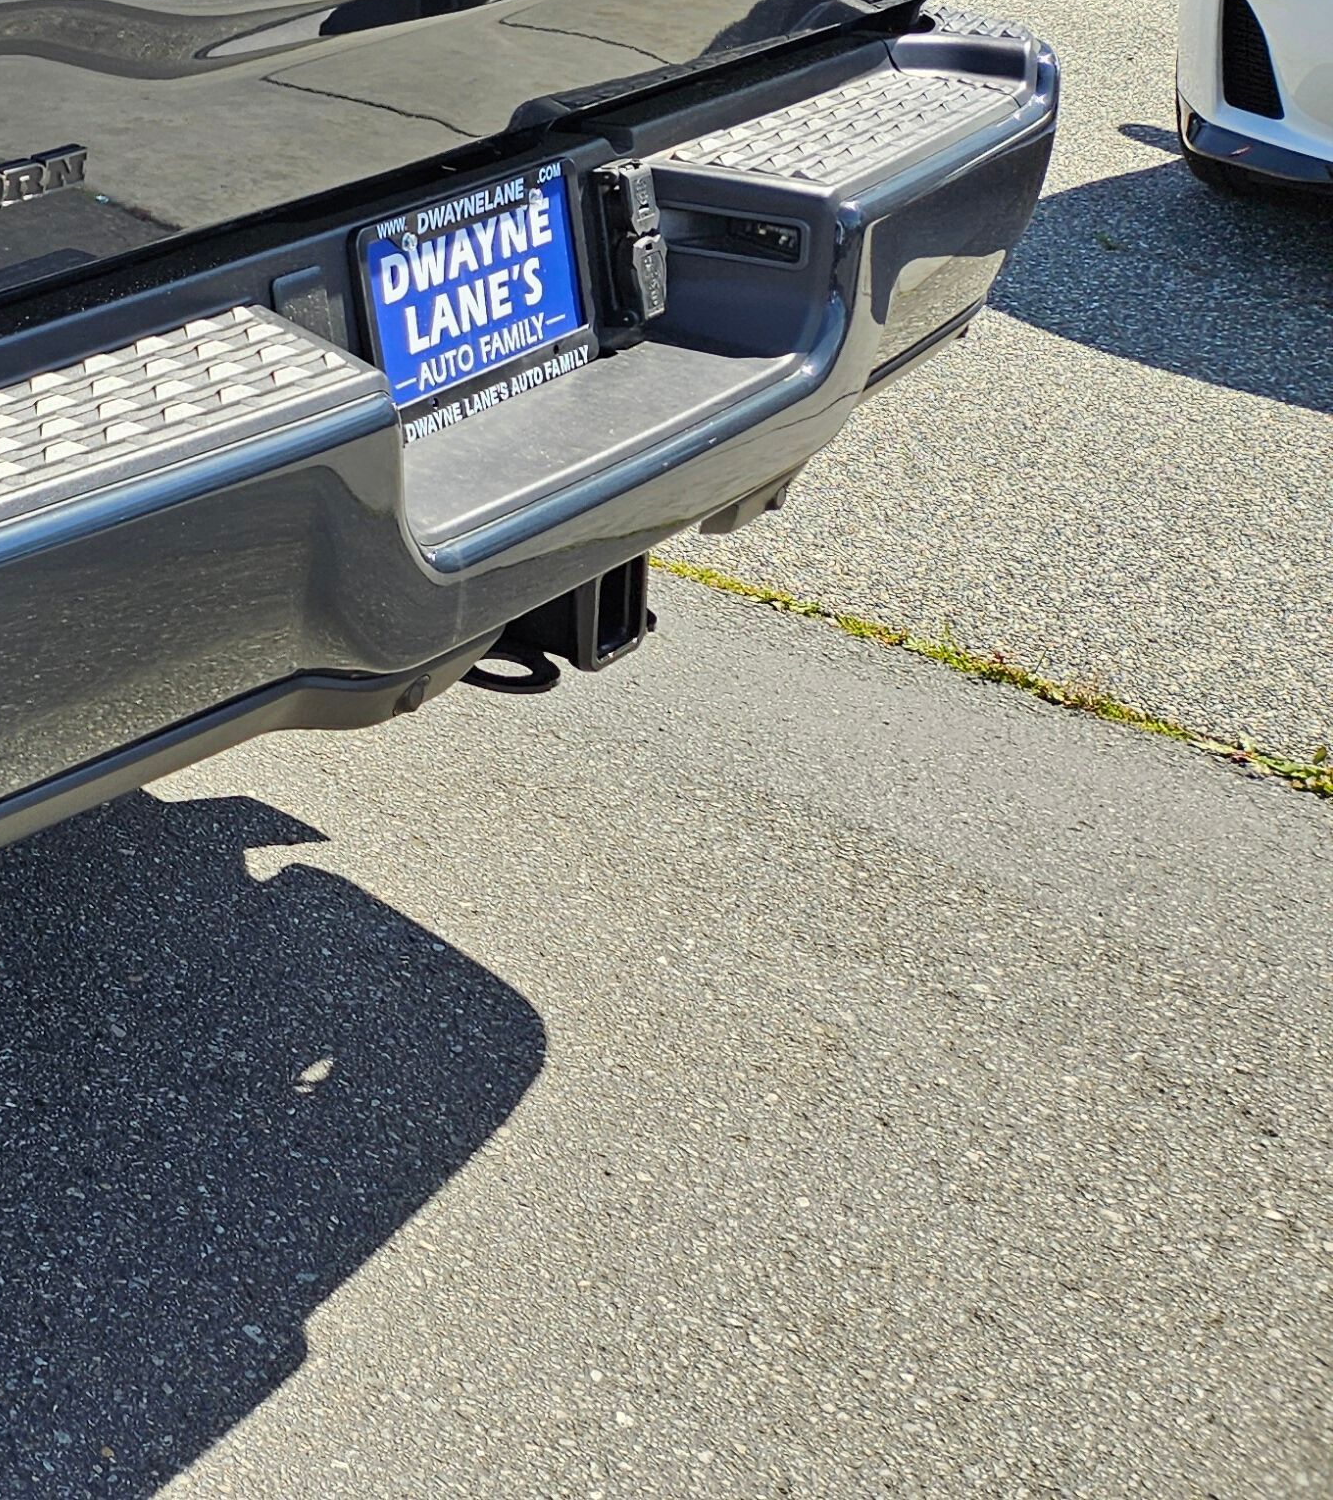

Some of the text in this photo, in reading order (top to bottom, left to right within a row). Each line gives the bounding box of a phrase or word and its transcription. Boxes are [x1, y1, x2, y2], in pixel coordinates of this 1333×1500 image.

[417, 177, 525, 235] DWAYNELANE
[537, 162, 562, 184] .COM
[380, 196, 553, 305] DWAYNE
[404, 256, 543, 356] LANE'S
[418, 312, 545, 392] AUTO FAMILY
[403, 345, 590, 444] DWAYNE LANE'S AUTO FAMILY
